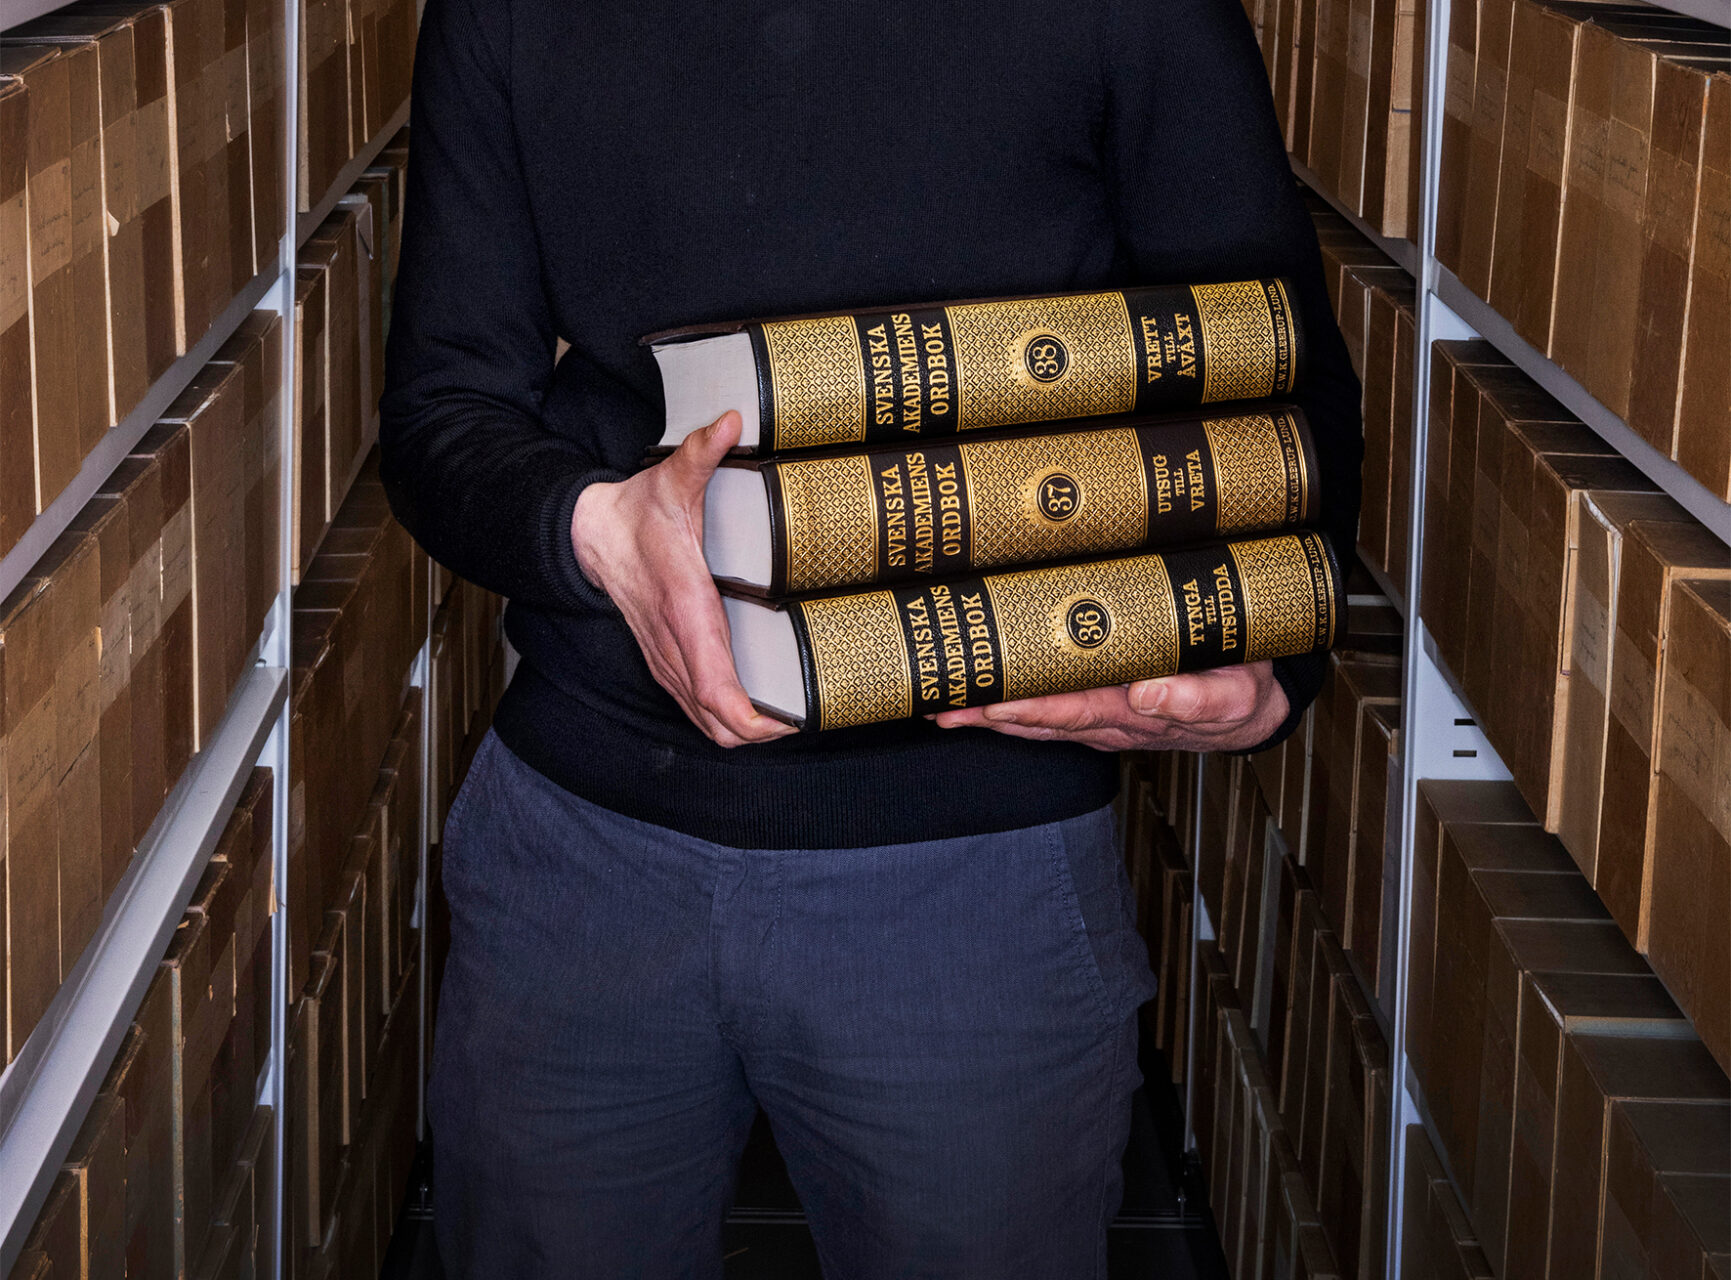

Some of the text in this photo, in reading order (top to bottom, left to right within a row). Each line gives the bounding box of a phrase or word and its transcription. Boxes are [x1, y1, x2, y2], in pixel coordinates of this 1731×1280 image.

[867, 323, 894, 425] SVENSKA
[891, 313, 921, 433] AKADEMIENS
[921, 322, 950, 415] ORDBOK
[1032, 344, 1058, 375] 38
[1141, 315, 1162, 384] VRETT
[1164, 332, 1176, 363] TILL
[1174, 313, 1196, 379] ÅVÄXT
[881, 463, 907, 567] SVENSKA
[905, 452, 933, 575] AKADEMIENS
[935, 462, 961, 556] ORDBOK
[1046, 483, 1073, 512] 37
[1152, 454, 1173, 514] UTSUG
[1173, 468, 1185, 497] TILL
[1185, 449, 1205, 512] VRETA
[961, 592, 994, 688] ORDBOK
[1076, 610, 1103, 641] 36
[1183, 578, 1205, 646] TYNGA
[1204, 595, 1217, 625] TILL
[1213, 563, 1237, 652] UTSUDDA
[906, 596, 940, 701] SVENSKA
[929, 585, 967, 707] AKADEMIENS
